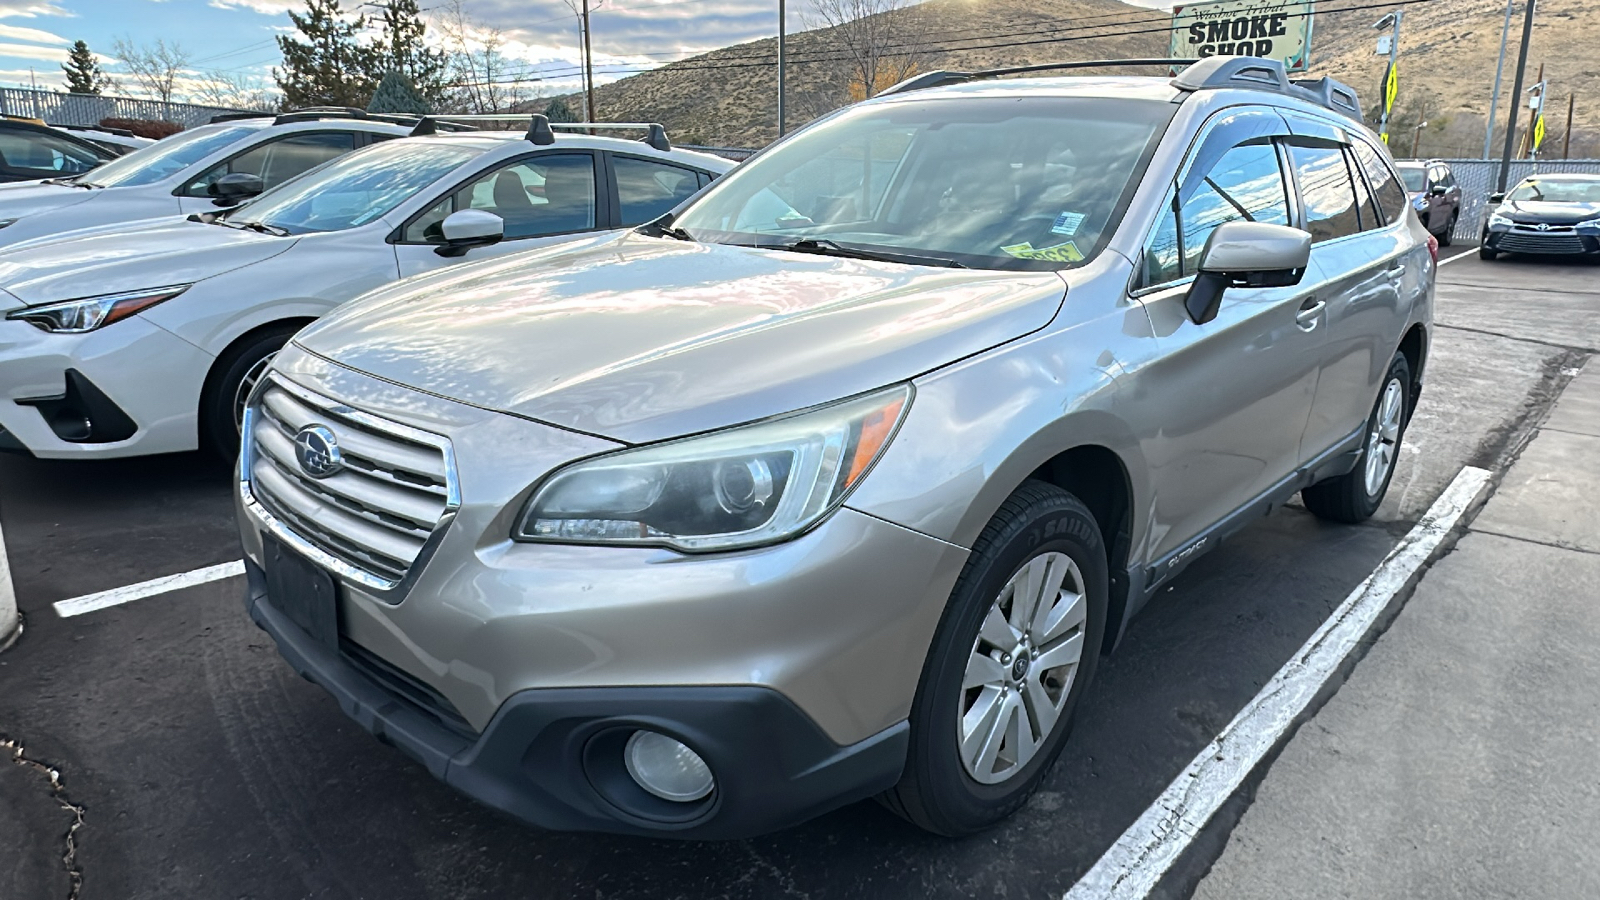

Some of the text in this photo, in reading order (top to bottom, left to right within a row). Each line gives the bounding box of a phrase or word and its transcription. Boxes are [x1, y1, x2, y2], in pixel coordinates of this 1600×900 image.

[1246, 1, 1287, 16] Tribal
[1188, 12, 1288, 45] SMOKE
[1198, 39, 1273, 58] SHOP
[1043, 515, 1098, 546] SAILUN
